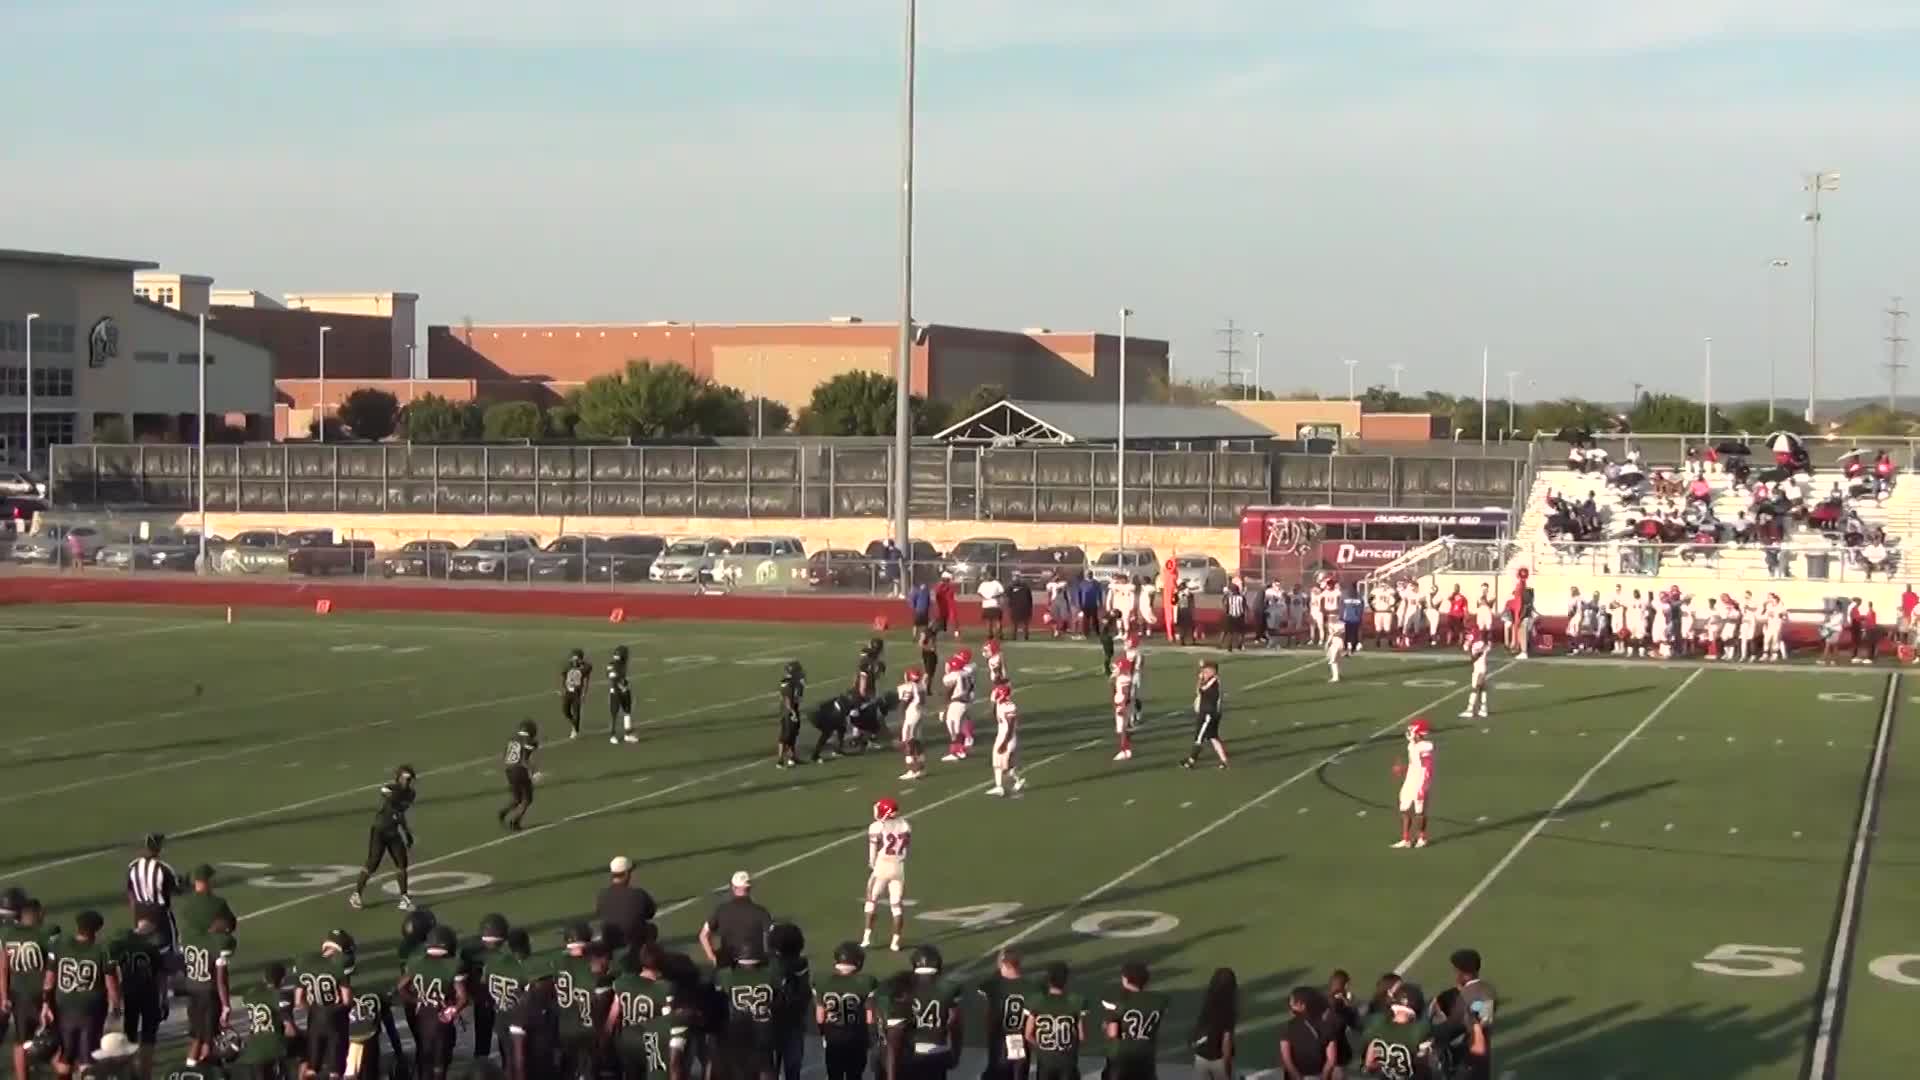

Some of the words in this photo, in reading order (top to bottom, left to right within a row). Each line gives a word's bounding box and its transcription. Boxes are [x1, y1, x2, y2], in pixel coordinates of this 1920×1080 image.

[885, 831, 911, 856] 27
[58, 957, 97, 992] 69
[731, 984, 773, 1022] 52
[1036, 1015, 1075, 1050] 20
